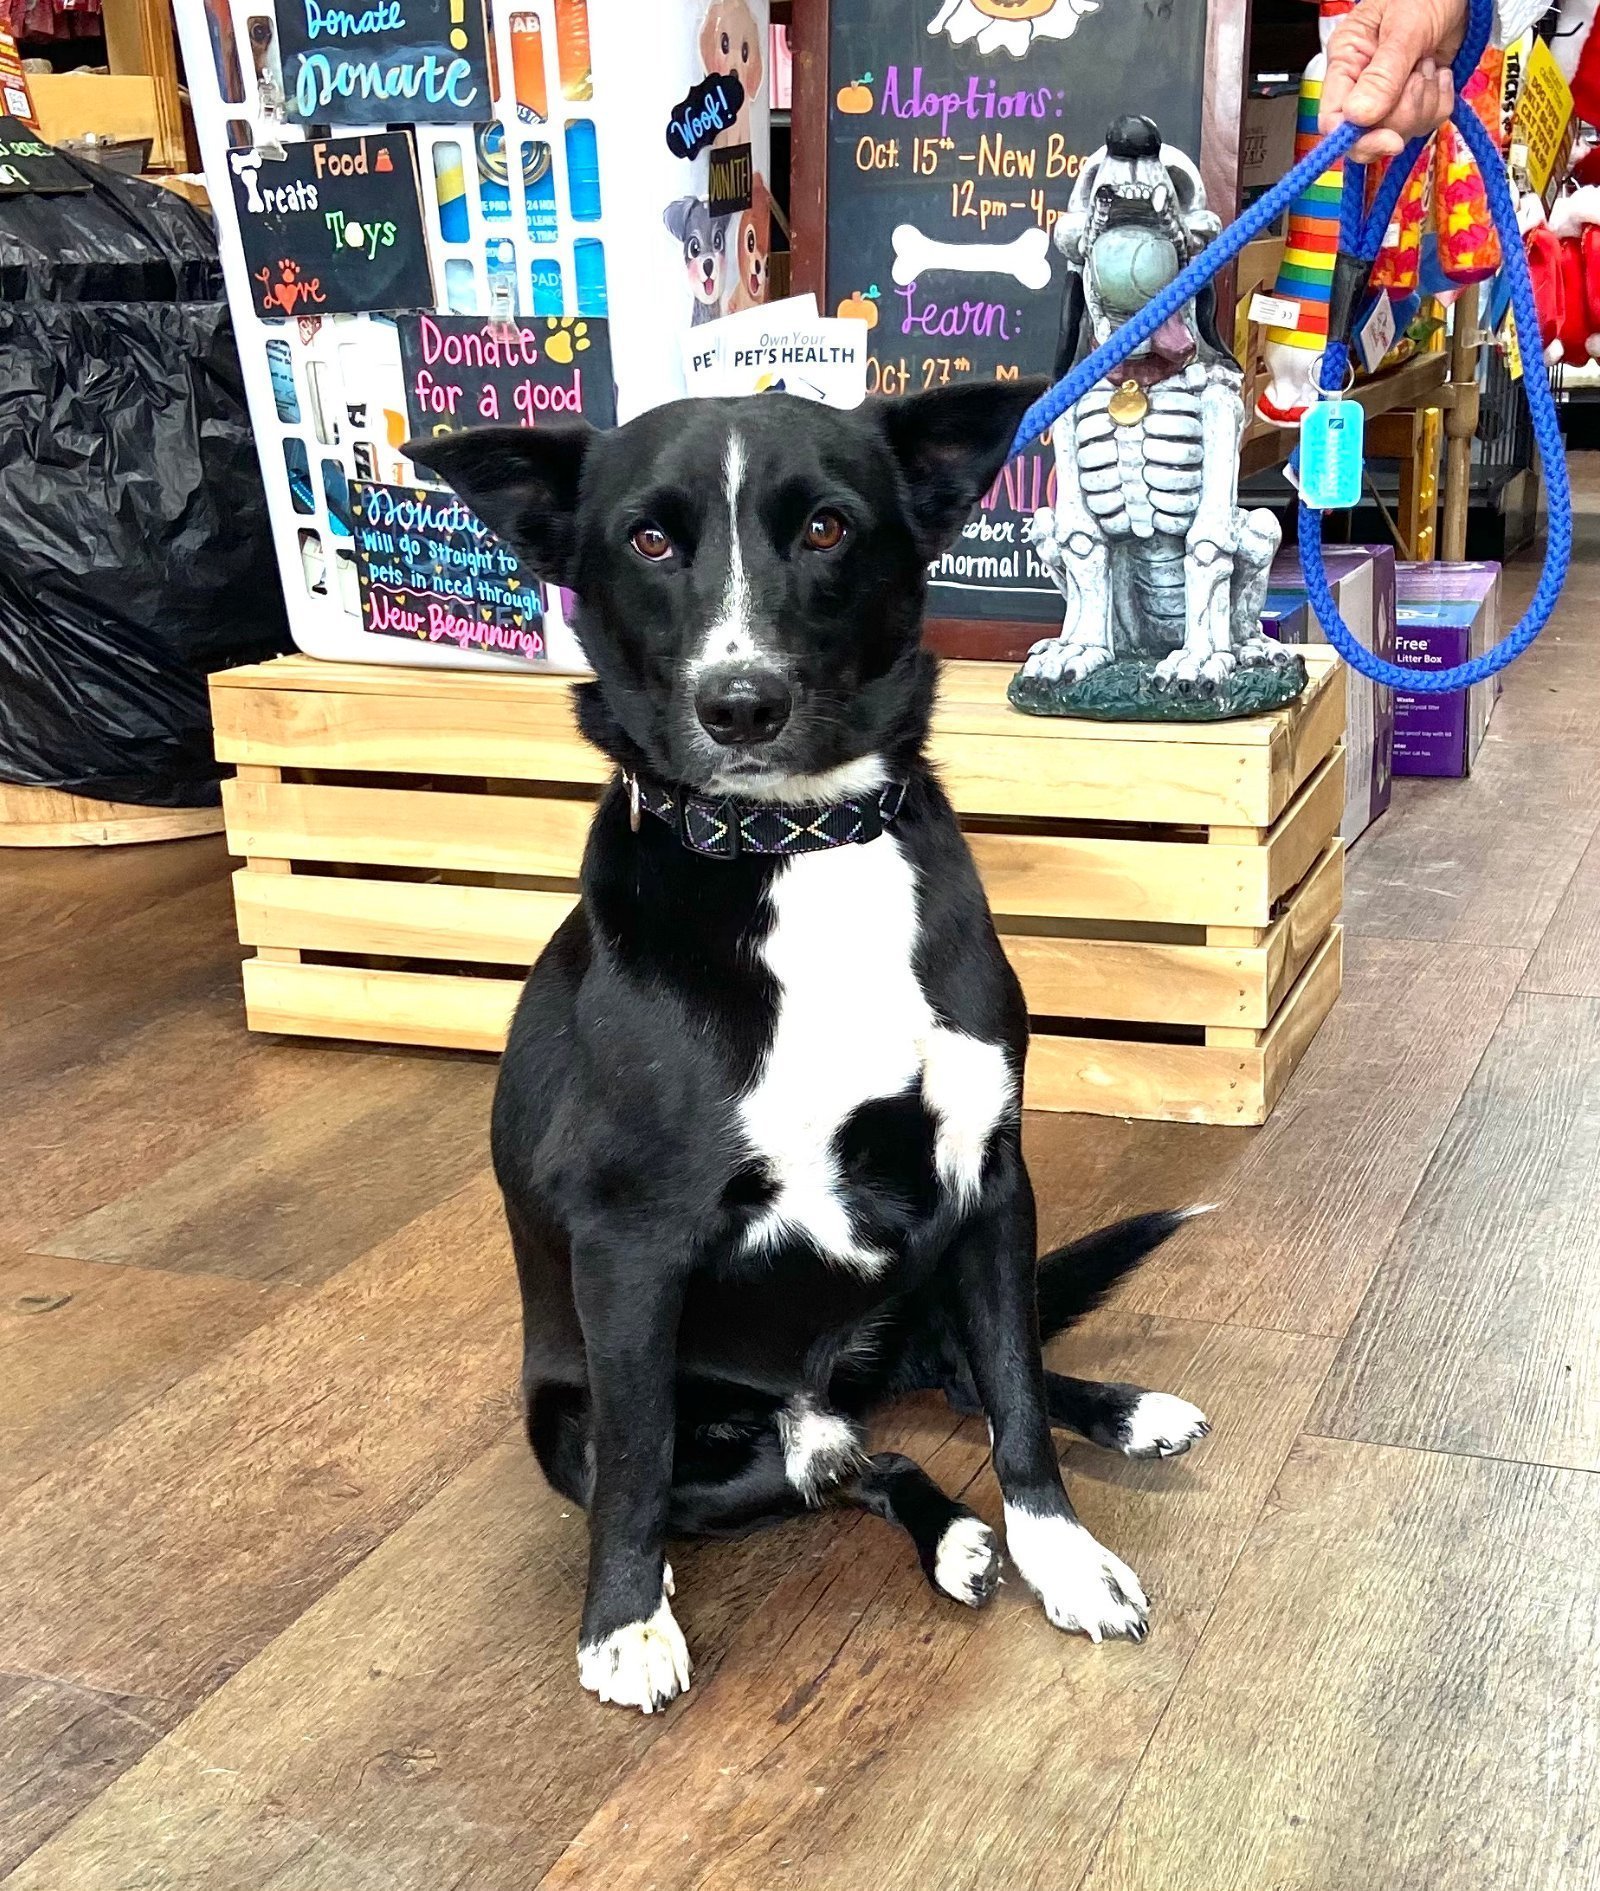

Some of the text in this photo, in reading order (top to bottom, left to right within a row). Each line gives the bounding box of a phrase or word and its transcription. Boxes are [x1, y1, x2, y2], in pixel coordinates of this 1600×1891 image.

[305, 0, 406, 39] Donate
[296, 53, 478, 117] Donate
[881, 66, 1064, 137] Adoptions:
[1503, 52, 1520, 113] TRICKS
[671, 85, 732, 149] Woof!
[230, 148, 319, 214] Treats
[313, 137, 368, 179] Food
[710, 152, 750, 203] DONATE!
[952, 180, 1065, 239] 12pm-4p
[325, 211, 397, 260] Toys
[254, 266, 326, 316] Love
[894, 281, 1023, 340] Learn:
[421, 315, 537, 368] Donate
[693, 350, 716, 372] PE
[734, 347, 854, 367] PET'S HEALTH
[760, 332, 826, 348] Own Your
[415, 368, 583, 428] for a good
[866, 357, 910, 395] Oct
[366, 486, 498, 541] Donati
[962, 514, 1034, 543] ober 3
[399, 534, 421, 564] go
[497, 550, 518, 572] to
[941, 549, 1052, 578] normal ho
[369, 562, 541, 621] pets in need through
[369, 591, 543, 659] New Beginnings
[1396, 654, 1442, 664] Litter Box
